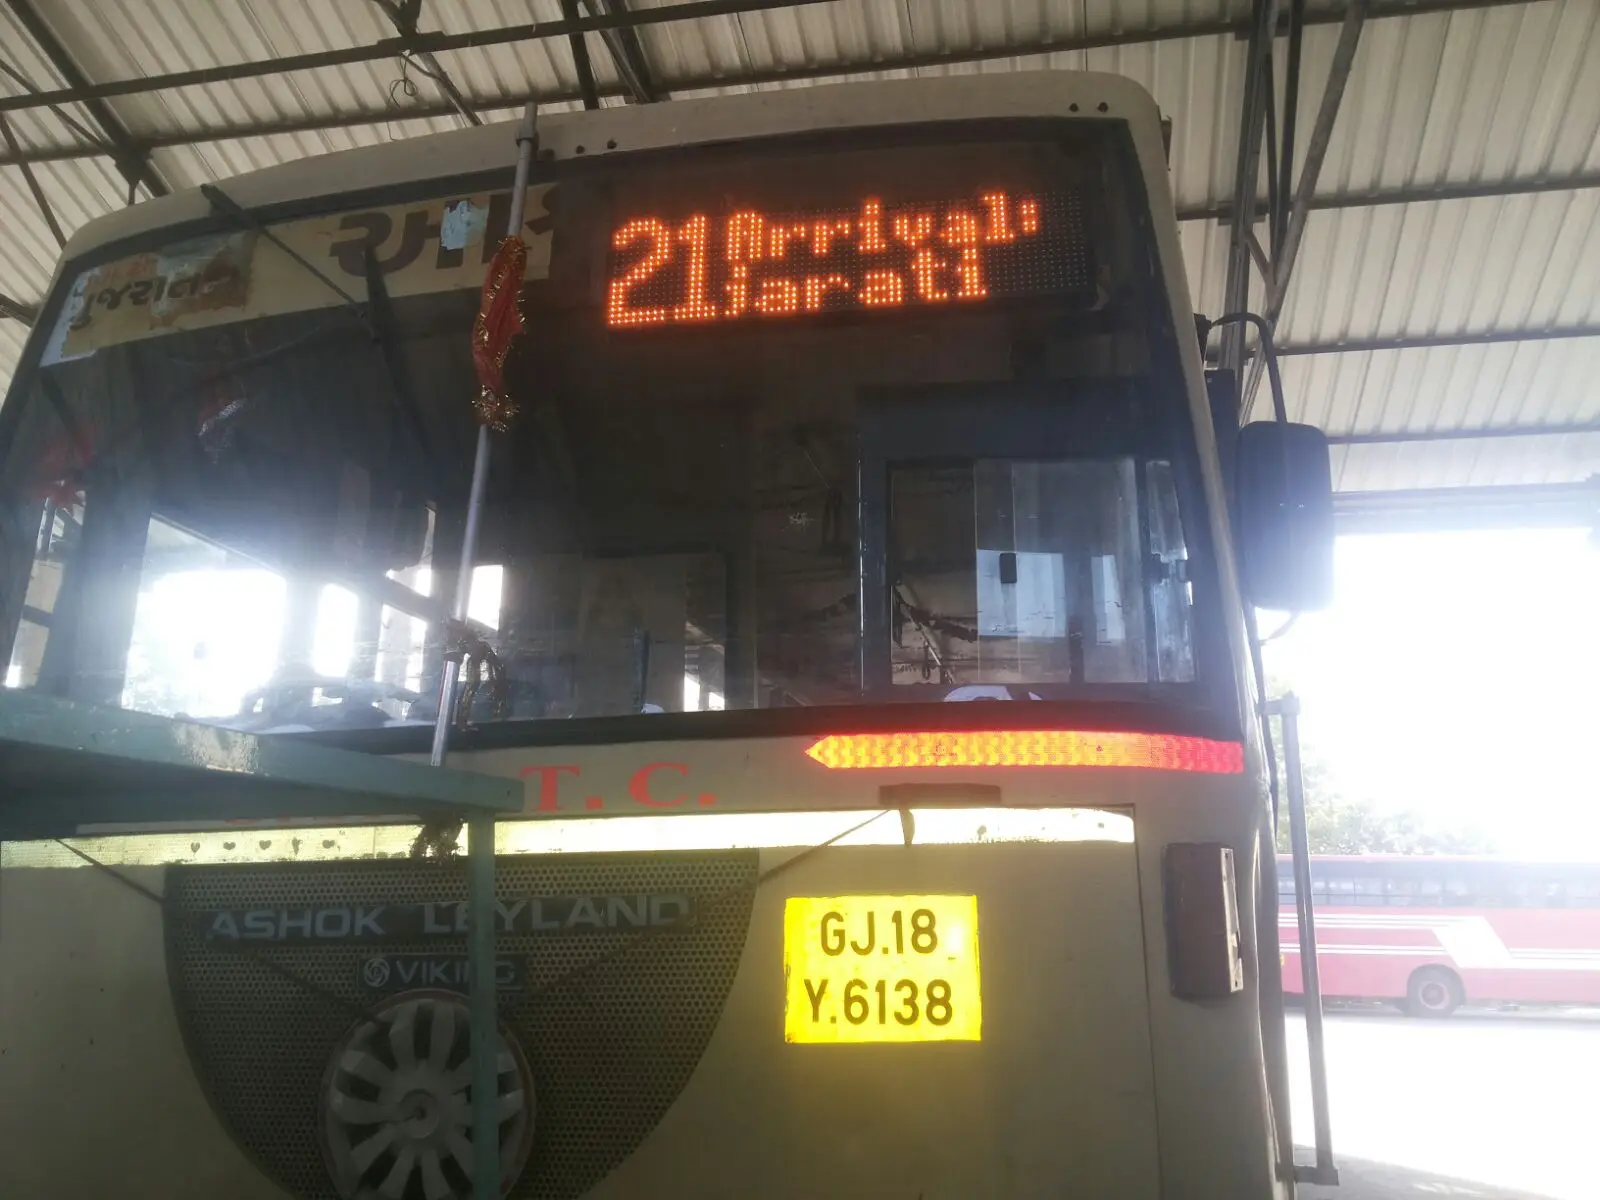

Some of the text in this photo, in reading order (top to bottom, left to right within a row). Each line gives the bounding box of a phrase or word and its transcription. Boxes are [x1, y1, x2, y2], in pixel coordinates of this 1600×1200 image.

[726, 190, 1038, 262] Arrival:
[606, 213, 717, 325] 21
[206, 908, 386, 940] ASHOK
[820, 908, 938, 956] GJ.18
[396, 959, 516, 985] VIKIG
[804, 978, 953, 1026] Y.6138
